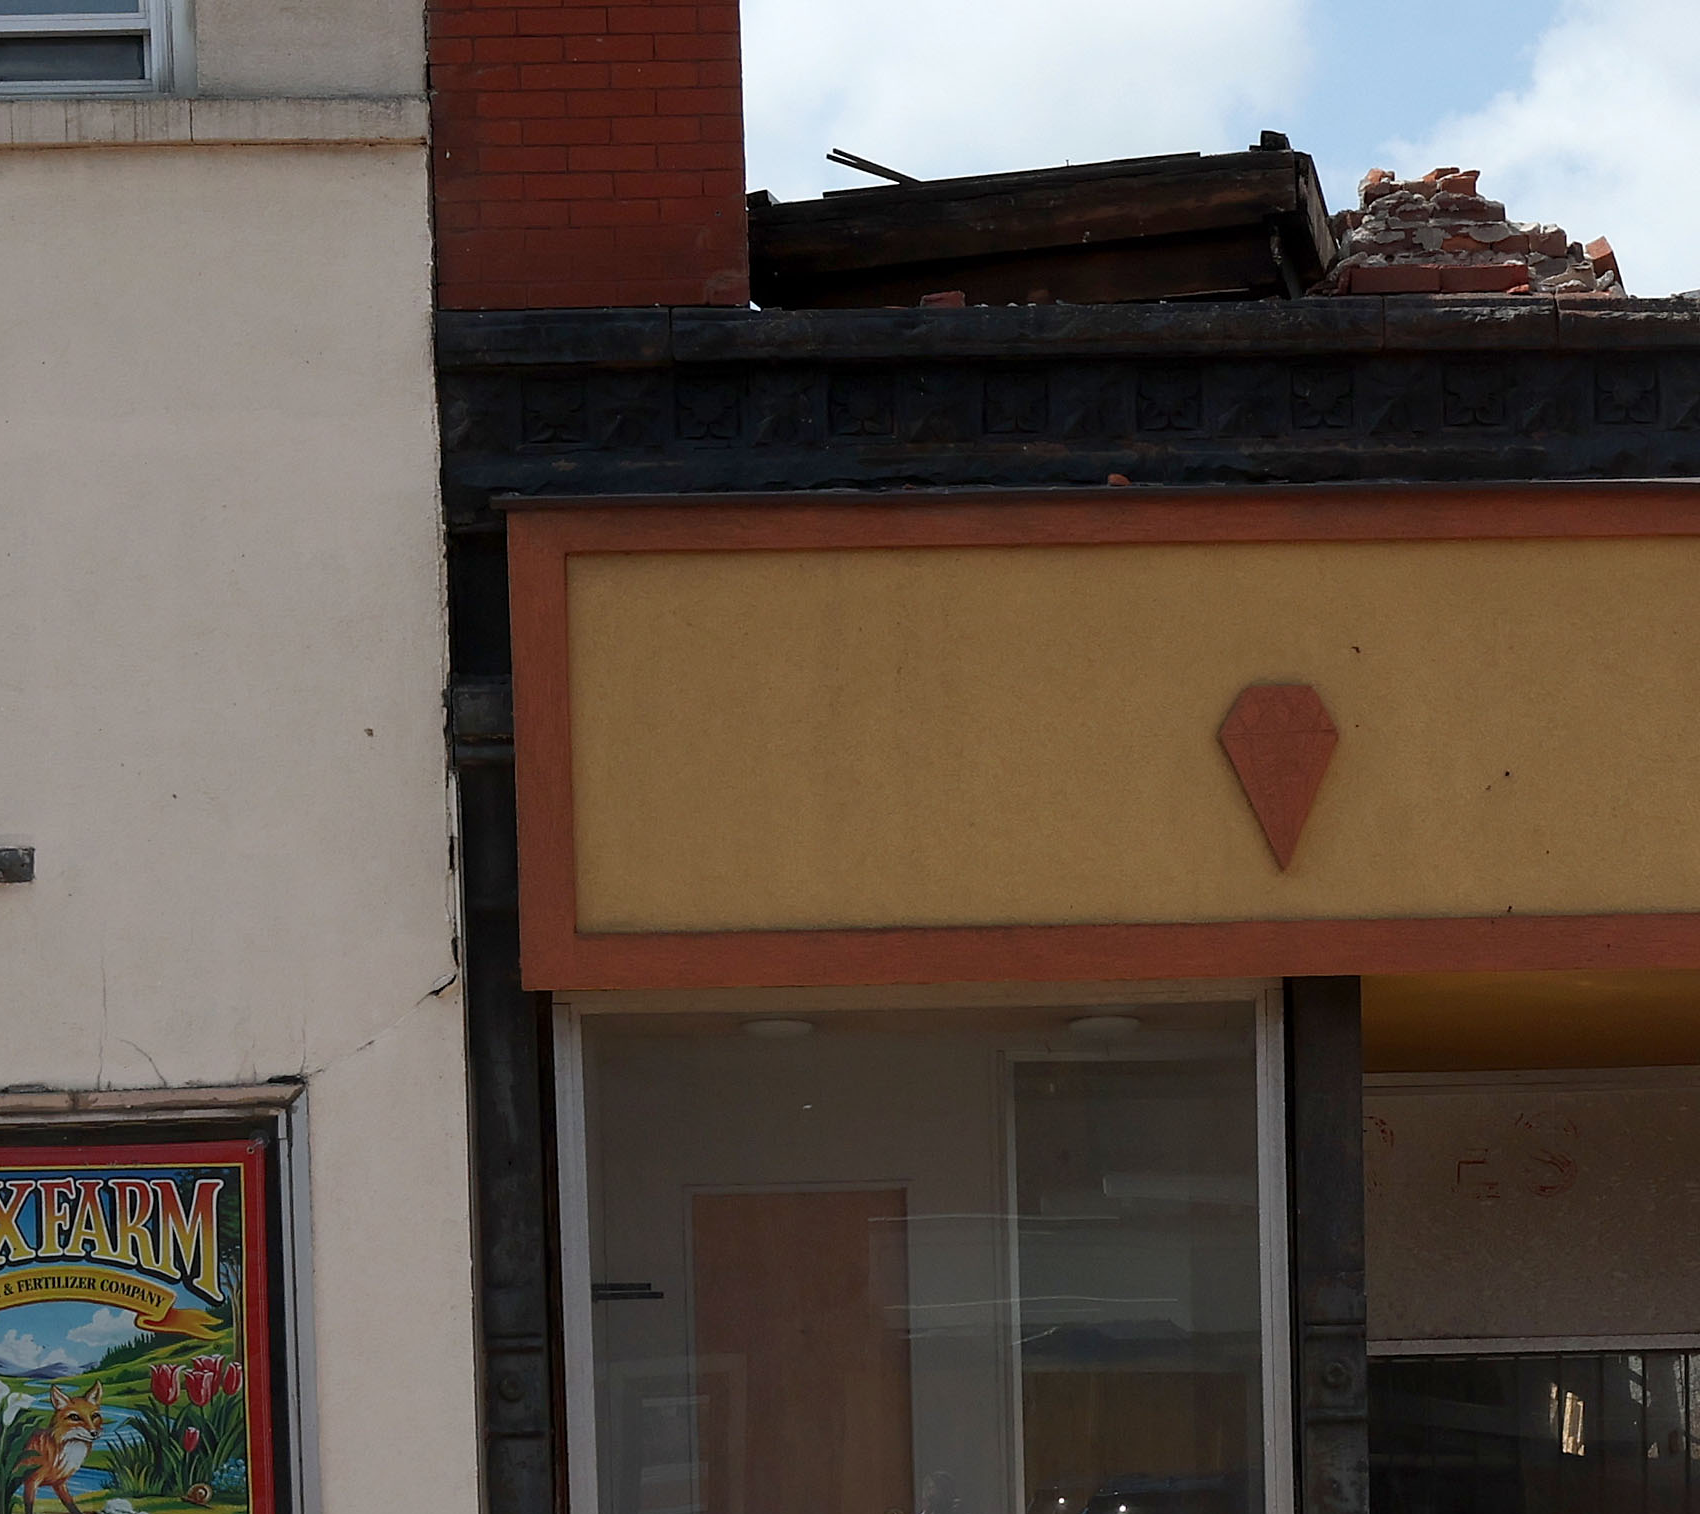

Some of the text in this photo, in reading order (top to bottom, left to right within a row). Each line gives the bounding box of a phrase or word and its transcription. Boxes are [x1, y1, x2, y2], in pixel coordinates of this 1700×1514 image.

[3, 1283, 14, 1296] &
[17, 1275, 97, 1294] FERTILIZER
[99, 1278, 167, 1308] COMPANY
